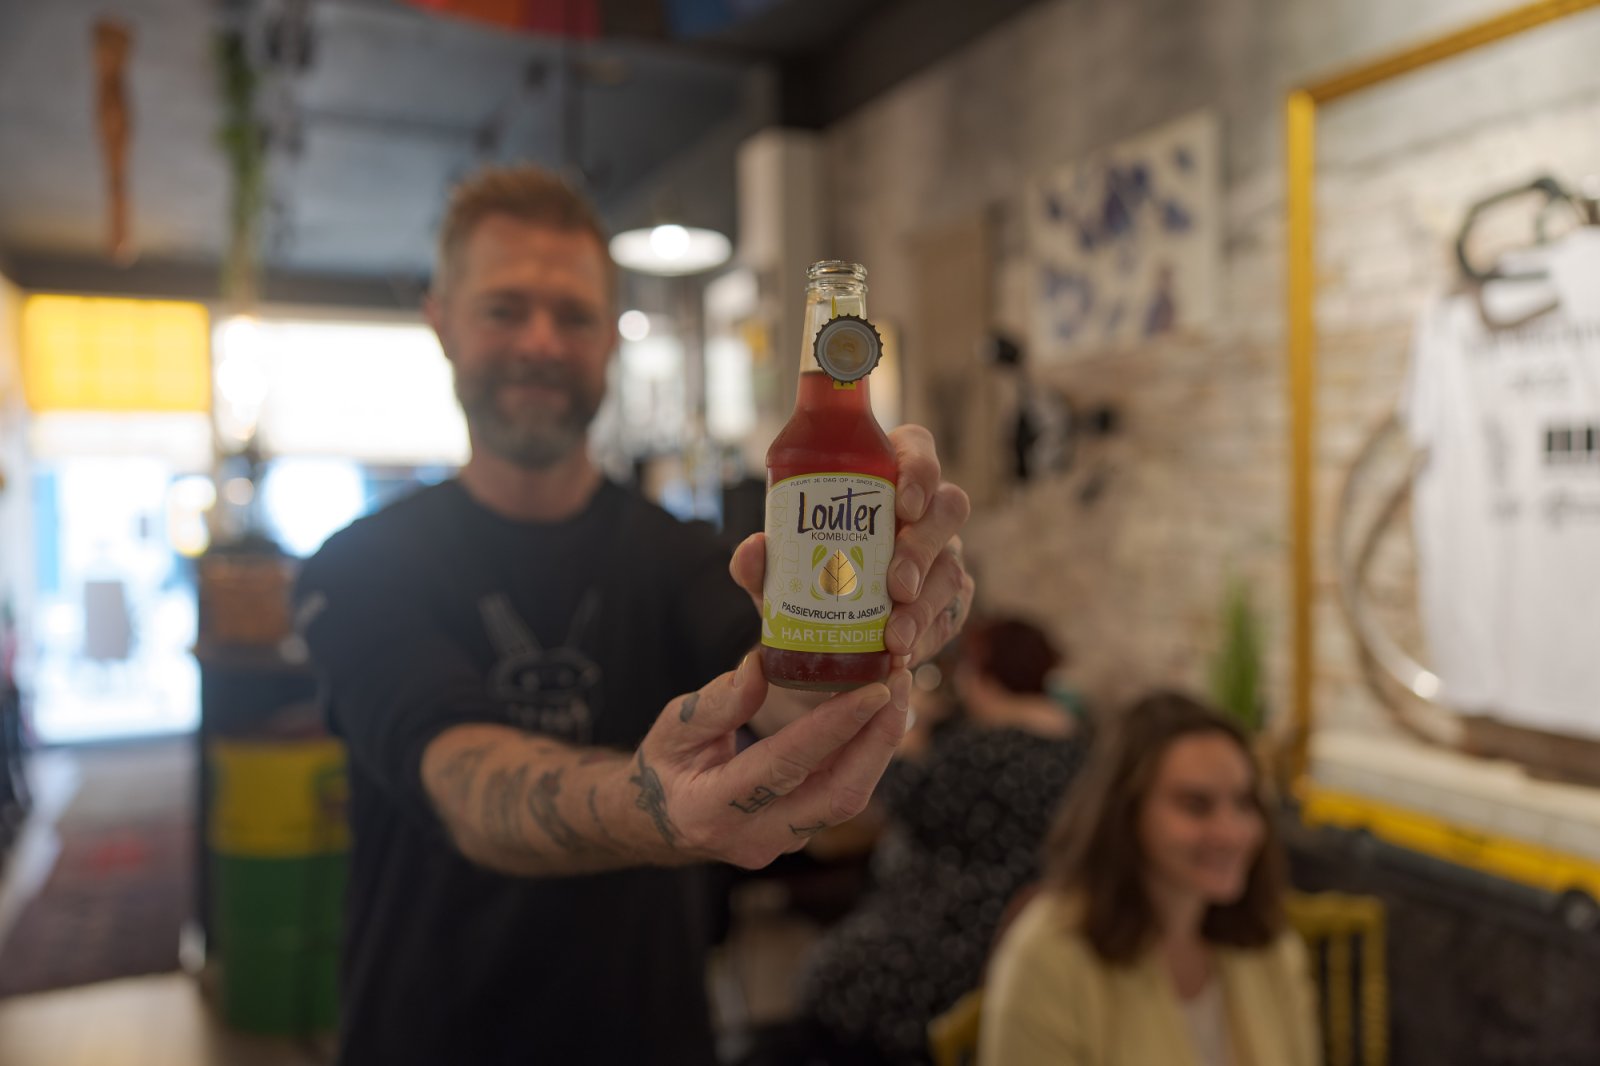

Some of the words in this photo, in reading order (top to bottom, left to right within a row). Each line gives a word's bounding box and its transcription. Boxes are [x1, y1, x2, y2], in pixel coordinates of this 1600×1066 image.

[797, 487, 882, 535] Louter
[811, 531, 869, 542] KOMBUCHA
[781, 601, 847, 620] PASSIEVRUCHT
[848, 611, 856, 620] &
[781, 627, 884, 643] HARTENDIEF
